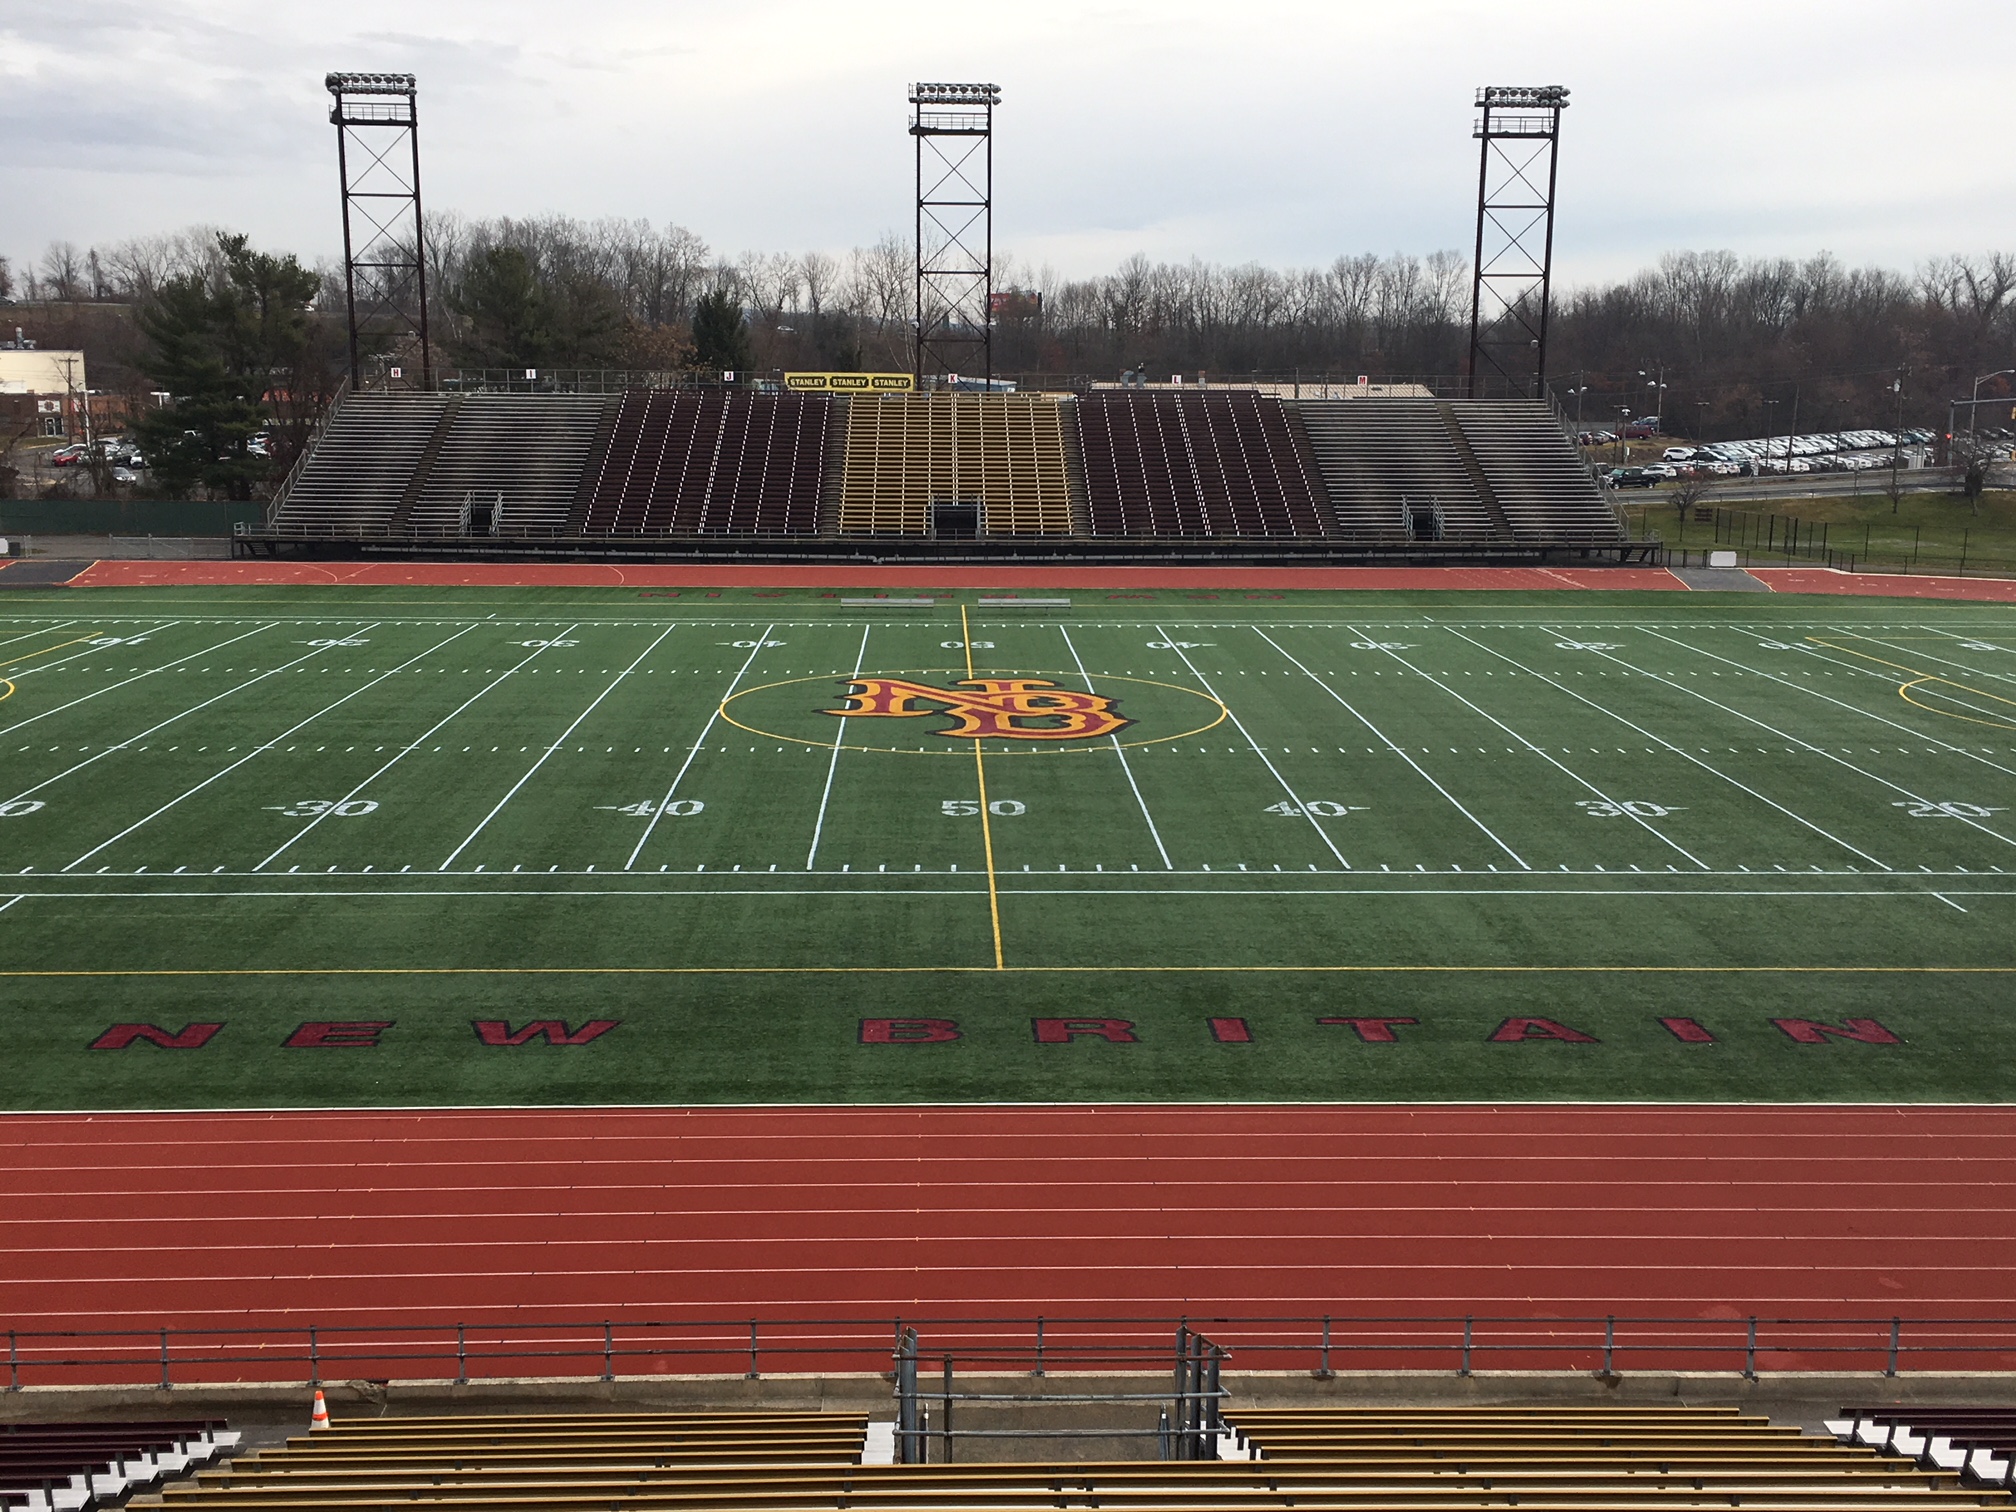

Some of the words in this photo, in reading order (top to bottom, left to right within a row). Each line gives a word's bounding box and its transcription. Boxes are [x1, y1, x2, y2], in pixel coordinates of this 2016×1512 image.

[790, 378, 824, 386] STANLEY
[832, 378, 866, 387] STANLEY
[874, 379, 908, 388] STANLEY
[520, 640, 580, 648] 30
[940, 641, 996, 649] 50
[283, 800, 380, 816] 30
[618, 800, 705, 816] 40
[940, 800, 1027, 816] 50
[1262, 801, 1349, 816] 40
[1574, 801, 1669, 817] 30
[1891, 802, 1991, 818] 20
[88, 1020, 621, 1049] NEW
[858, 1017, 1900, 1045] BRITAIN
